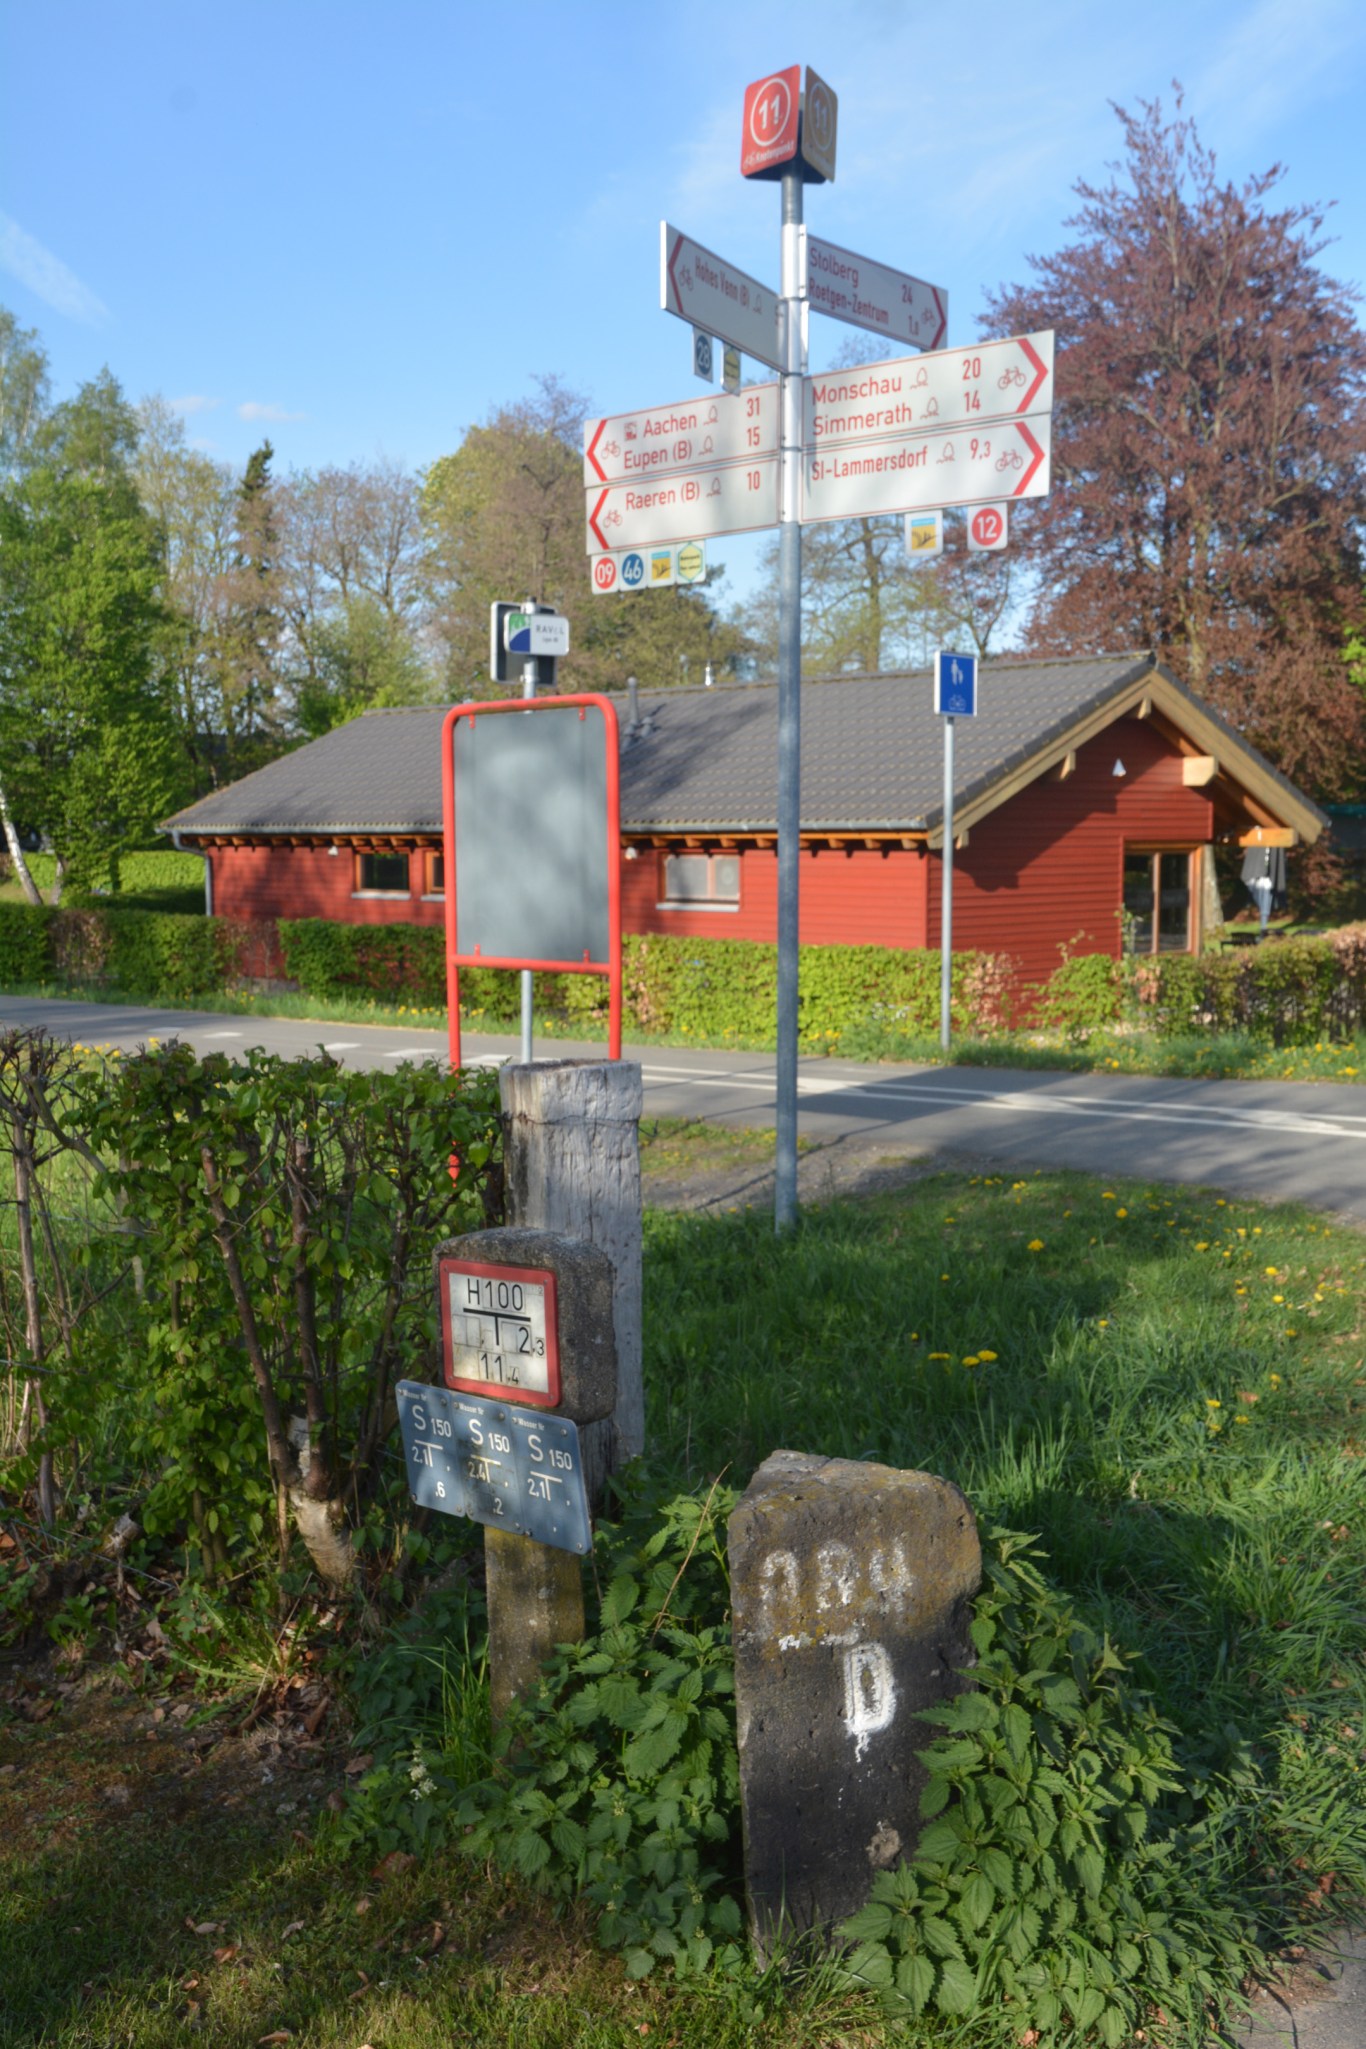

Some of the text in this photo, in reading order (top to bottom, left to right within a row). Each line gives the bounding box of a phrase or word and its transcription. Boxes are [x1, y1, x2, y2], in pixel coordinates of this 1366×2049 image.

[758, 94, 781, 130] 11
[810, 247, 859, 288] Stolberg
[808, 276, 889, 325] Roetgen-Zentrum
[901, 283, 913, 305] 24
[812, 357, 981, 405] Monschau 20
[643, 398, 760, 438] Aachen 31
[812, 390, 981, 436] Simmerath 14
[624, 428, 760, 471] Eupen (B) 15
[970, 438, 991, 460] 9,3
[626, 471, 760, 512] Raeren (B) 10
[976, 515, 997, 539] 12
[596, 565, 614, 583] 09
[623, 560, 643, 579] 46
[412, 1405, 452, 1438] S 150
[468, 1418, 510, 1453] S 150
[527, 1434, 573, 1471] S 150
